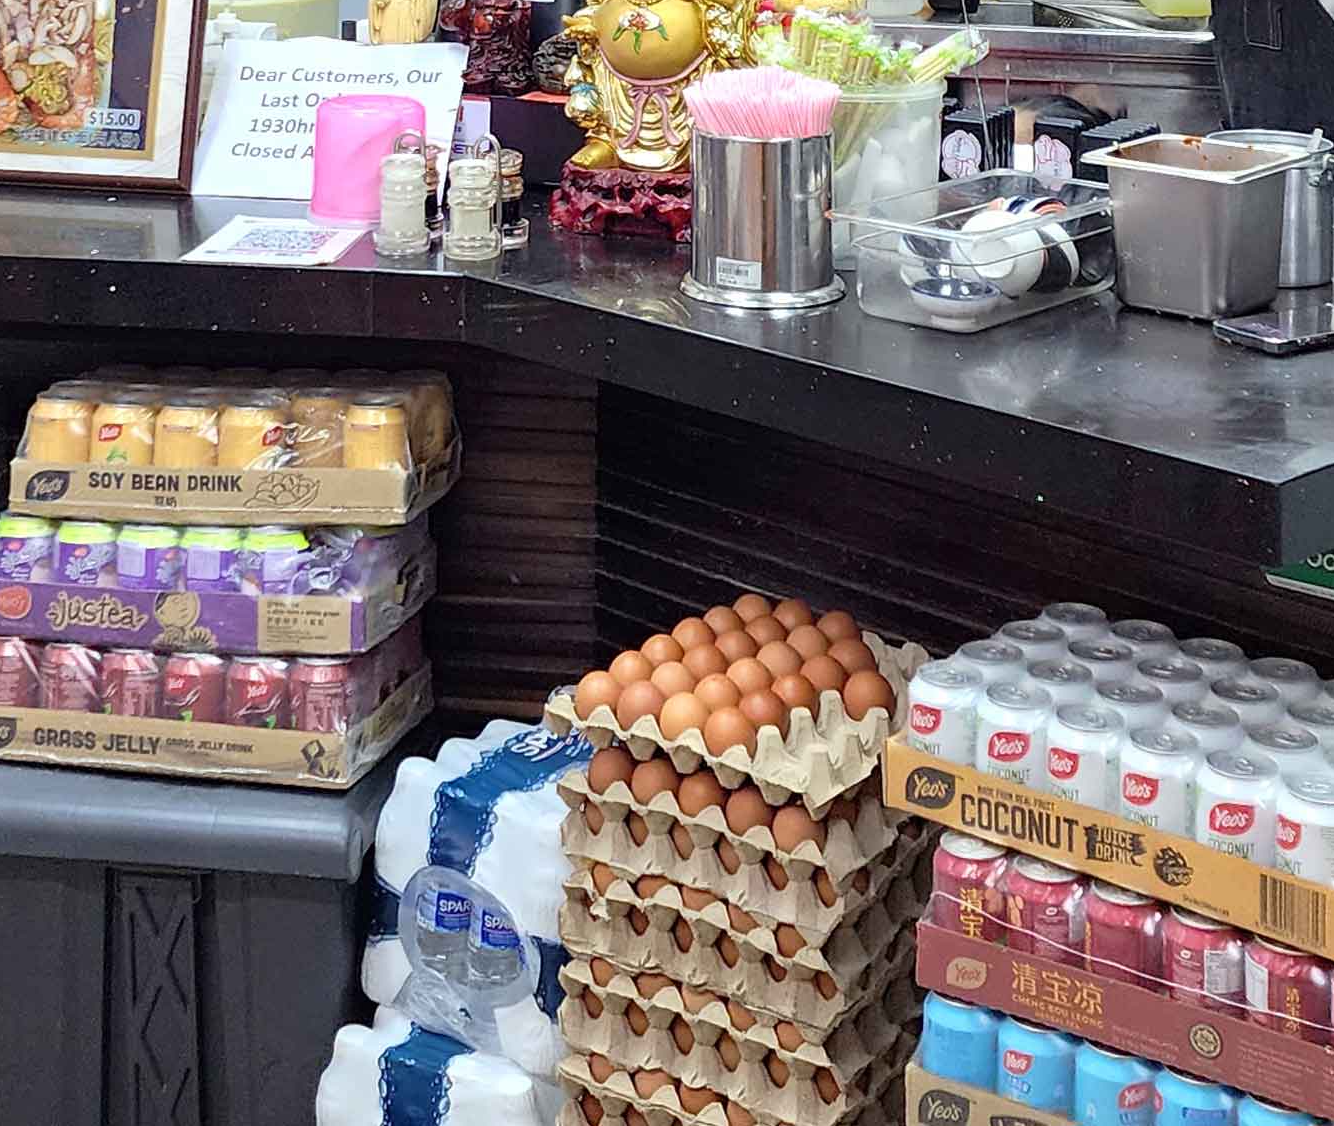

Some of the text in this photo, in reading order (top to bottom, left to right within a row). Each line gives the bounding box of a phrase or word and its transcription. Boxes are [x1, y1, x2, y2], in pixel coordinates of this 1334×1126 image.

[239, 65, 442, 86] Dear Customers, Our
[260, 92, 300, 108] Last
[89, 111, 137, 127] $15.00
[230, 142, 296, 160] Closed
[88, 472, 243, 493] SOY BEAN DRINK
[33, 726, 160, 755] GRASS JELLY
[993, 734, 1024, 756] Yeo's
[914, 775, 949, 799] Yeo's
[1125, 778, 1153, 797] Yeo's
[960, 793, 1079, 852] COCONUT
[1216, 808, 1248, 830] Yeo's
[1096, 823, 1134, 851] JUICE
[1095, 843, 1134, 866] DRINK
[1011, 961, 1104, 1015] 清宝凉
[927, 1096, 963, 1121] Yeo's
